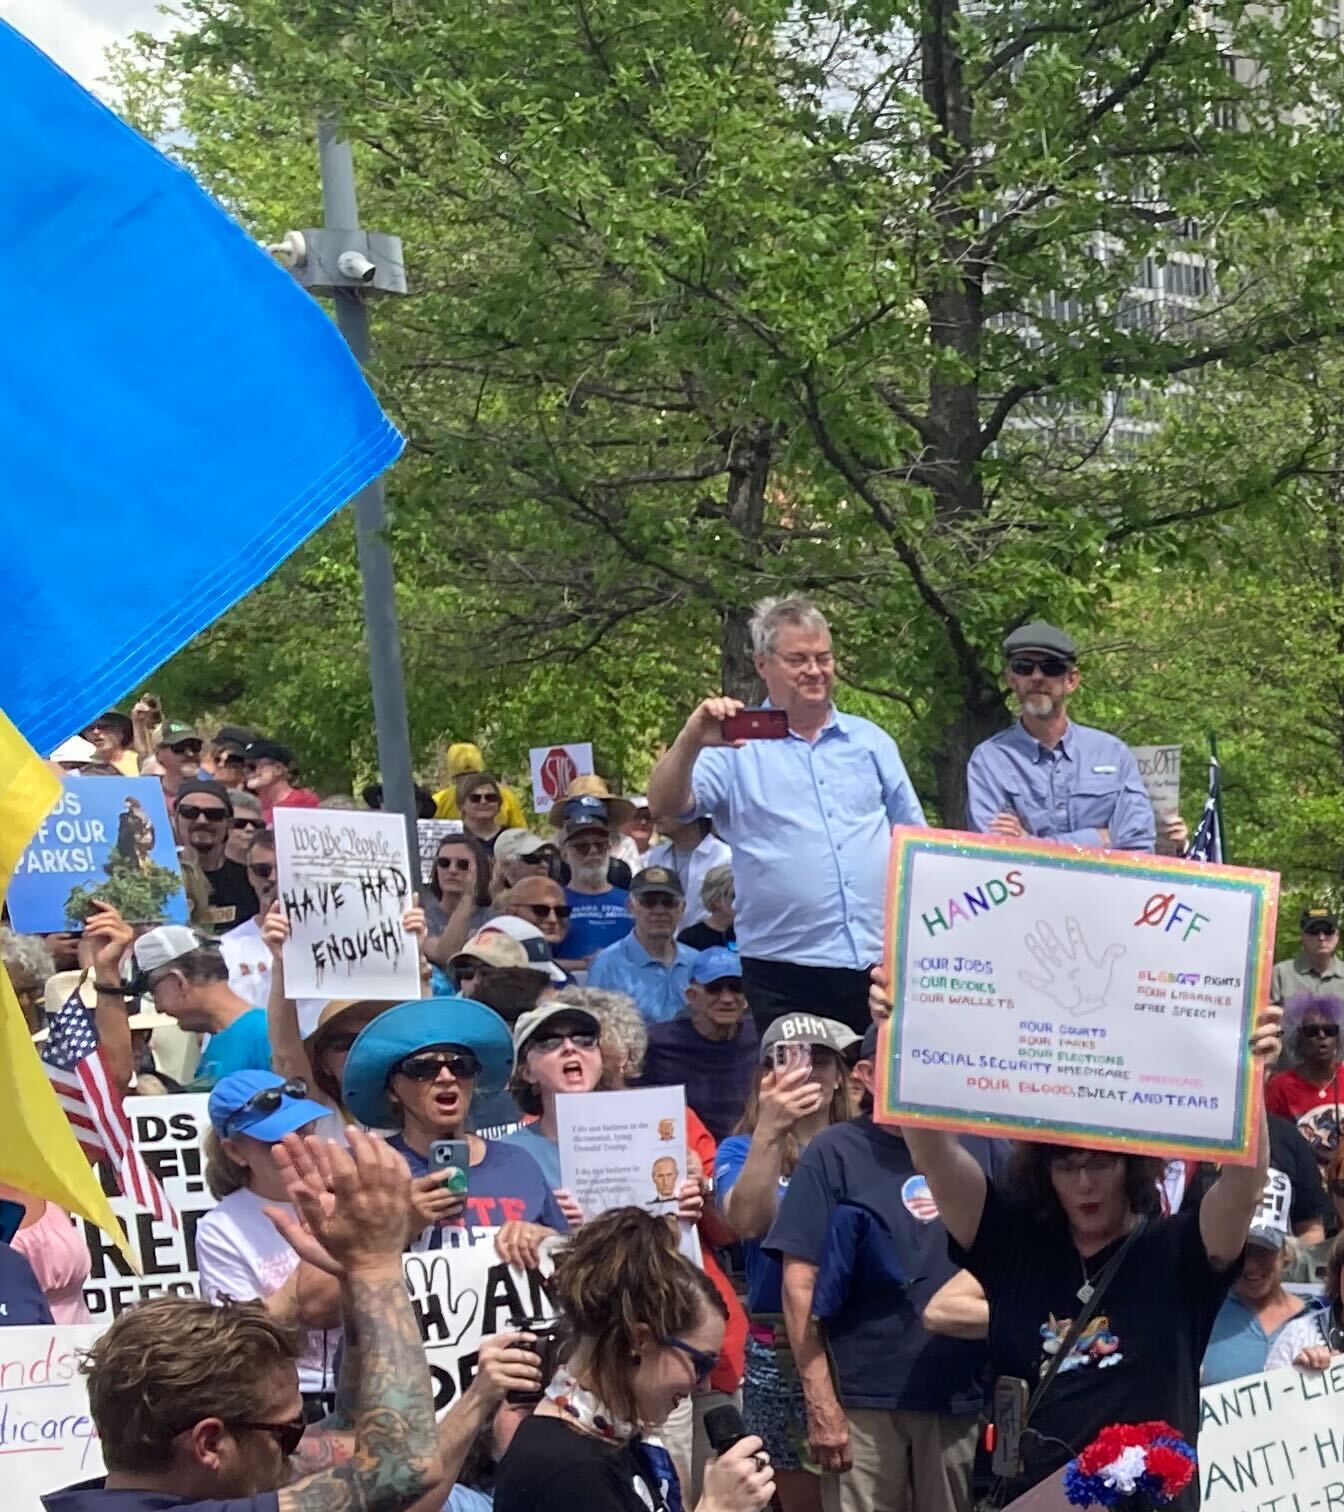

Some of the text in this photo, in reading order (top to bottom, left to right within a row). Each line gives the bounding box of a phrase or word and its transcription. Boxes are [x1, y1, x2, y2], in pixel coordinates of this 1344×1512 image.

[55, 819, 108, 844] OUR
[282, 881, 345, 932] HAVE
[358, 866, 409, 914] HAD
[921, 870, 1026, 937] HANDS
[311, 917, 405, 970] ENOUGH!
[920, 957, 994, 975] OUR JOBS
[919, 976, 948, 989] OUR
[919, 993, 1015, 1010] OUR WALLETS
[781, 1016, 827, 1040] BHM
[921, 1049, 976, 1066] SOCIAL
[978, 1055, 1052, 1075] SECURITY
[977, 1076, 1011, 1092] OUR
[1132, 1091, 1163, 1106] AND
[1164, 1094, 1220, 1111] TEARS
